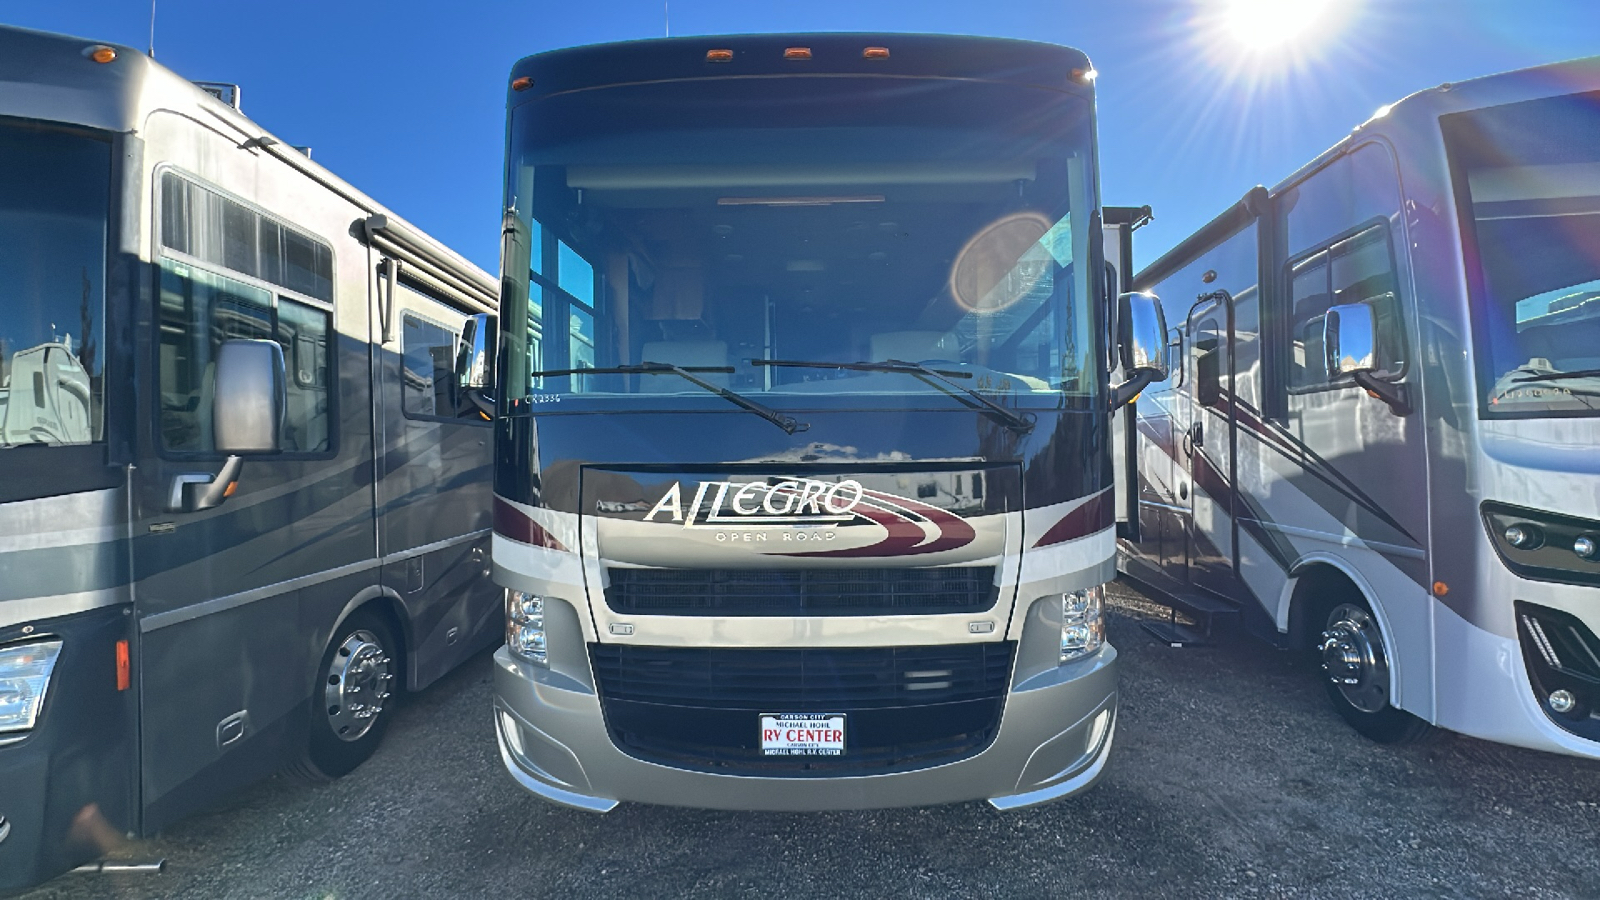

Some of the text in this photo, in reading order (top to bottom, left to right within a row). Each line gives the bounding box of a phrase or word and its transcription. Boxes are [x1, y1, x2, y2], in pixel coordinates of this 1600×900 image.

[643, 479, 863, 530] ALLEGRO
[715, 531, 836, 543] OPEN ROAD
[764, 729, 843, 742] RV CENTER
